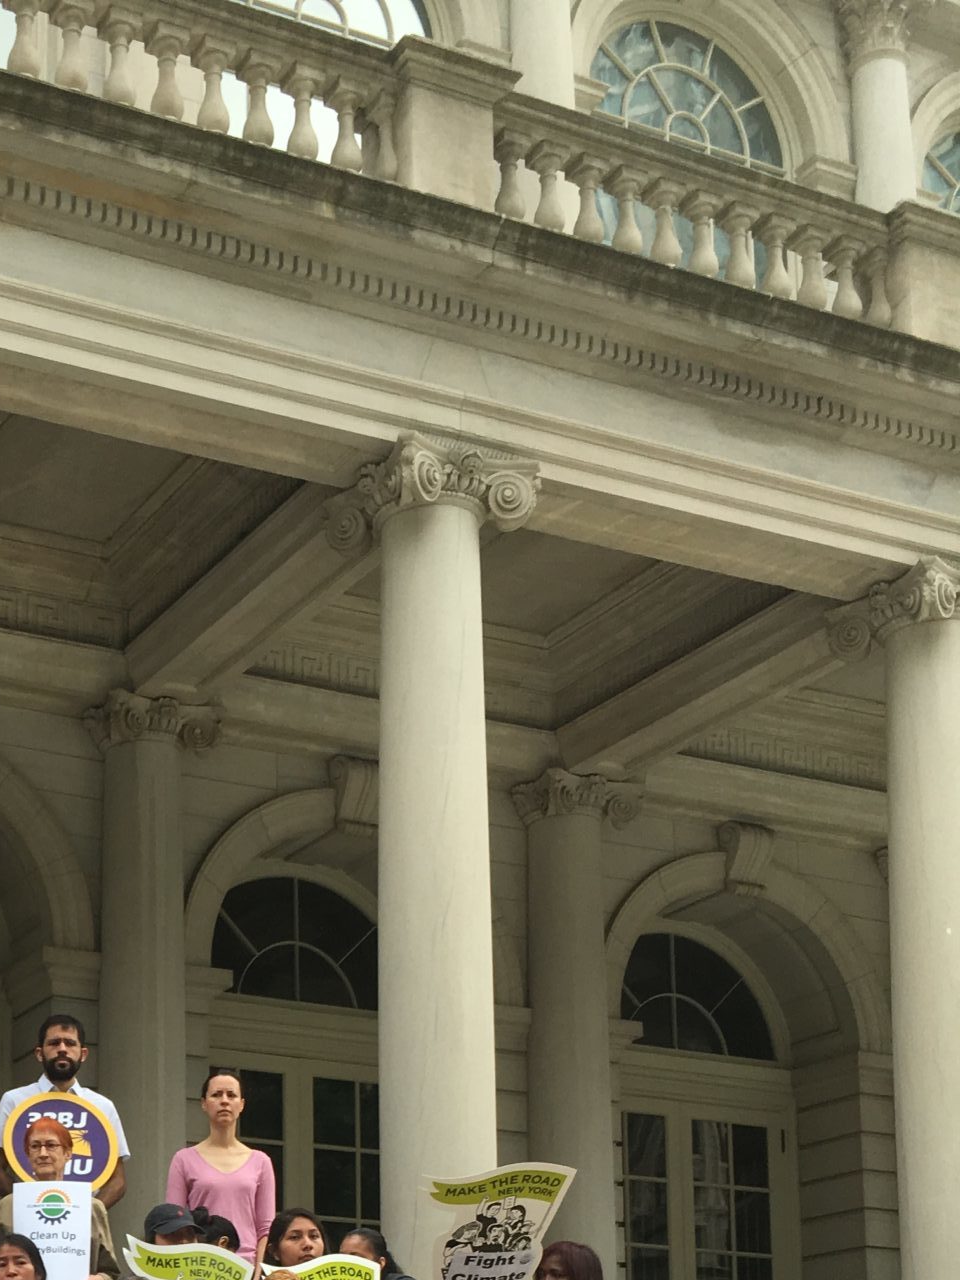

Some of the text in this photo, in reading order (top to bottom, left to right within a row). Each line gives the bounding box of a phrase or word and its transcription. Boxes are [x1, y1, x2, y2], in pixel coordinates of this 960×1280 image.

[444, 1174, 561, 1197] MAKE THE ROAD
[497, 1186, 556, 1198] NEW YORK
[30, 1232, 76, 1241] Clean Up
[145, 1255, 181, 1269] MAKE
[183, 1255, 207, 1269] THE
[464, 1254, 516, 1269] Fight
[189, 1268, 213, 1279] NEW
[315, 1266, 338, 1280] THE
